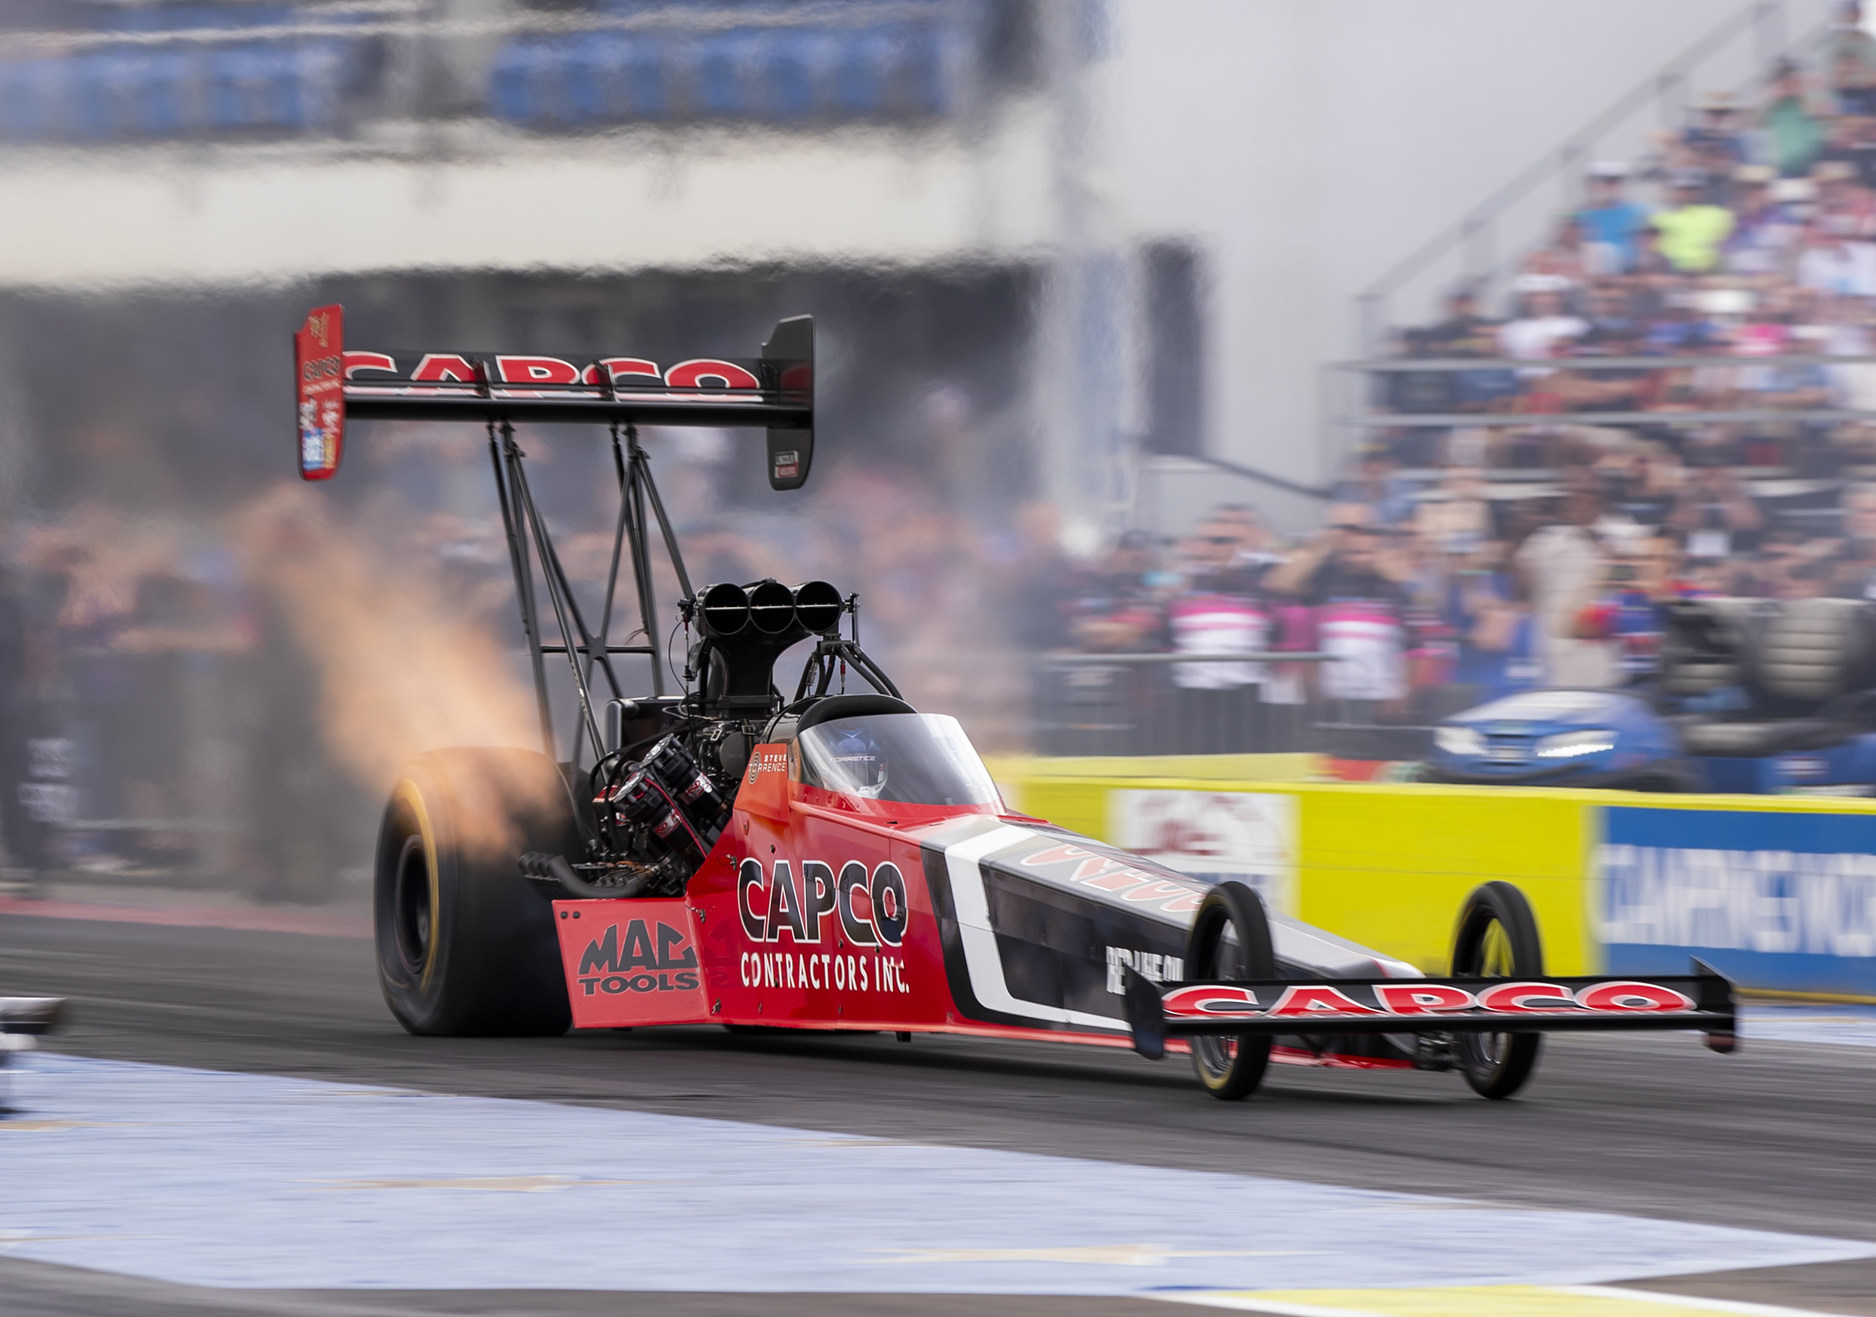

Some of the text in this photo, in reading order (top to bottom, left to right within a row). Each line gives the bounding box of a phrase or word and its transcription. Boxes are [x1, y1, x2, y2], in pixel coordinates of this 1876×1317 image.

[343, 350, 763, 402] CAPCO
[748, 762, 786, 773] TORRENCE
[764, 753, 787, 763] STEVE
[737, 857, 909, 948] CAPCO
[577, 918, 700, 976] MAC
[577, 971, 700, 997] TOOLS
[740, 951, 911, 994] CONTRACTORS INC.
[1161, 980, 1699, 1018] CAPCO
